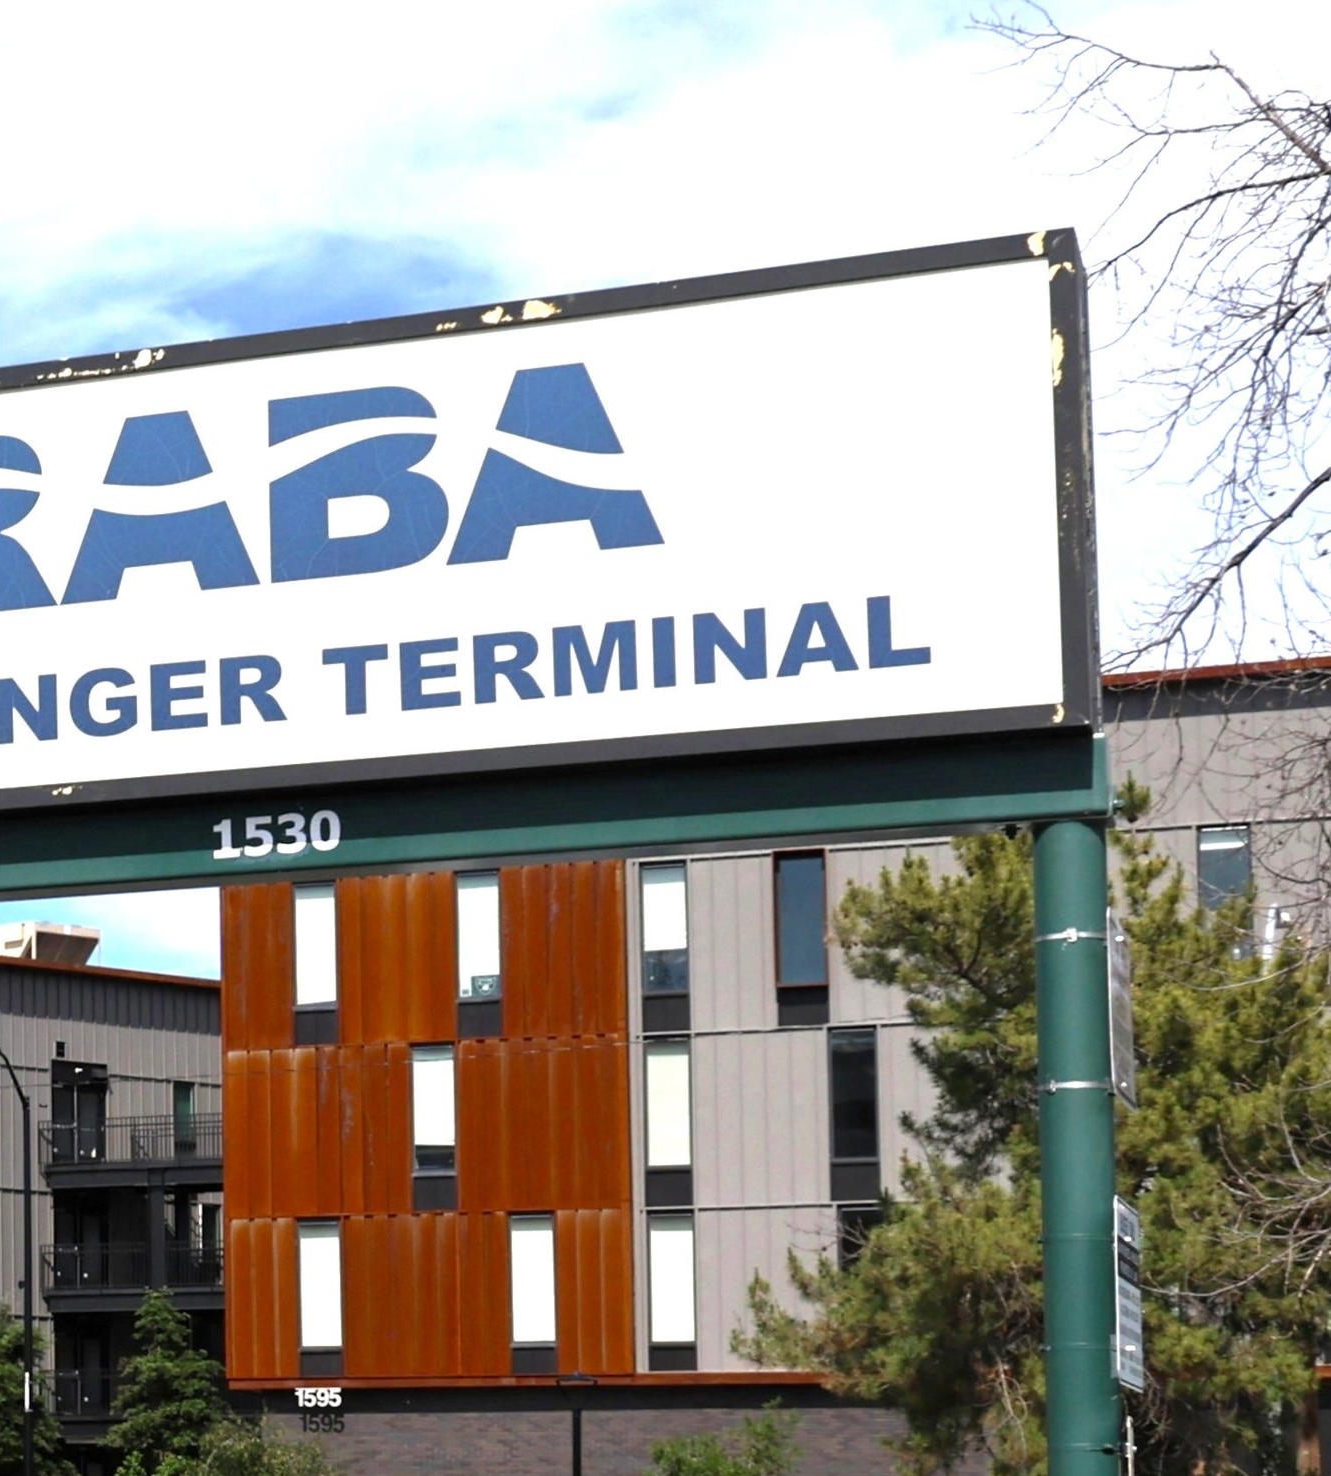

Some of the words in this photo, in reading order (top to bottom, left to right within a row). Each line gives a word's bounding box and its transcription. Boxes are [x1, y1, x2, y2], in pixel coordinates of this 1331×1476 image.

[321, 595, 932, 716] TERMINAL
[212, 810, 341, 860] 1530
[294, 1386, 342, 1408] 1595
